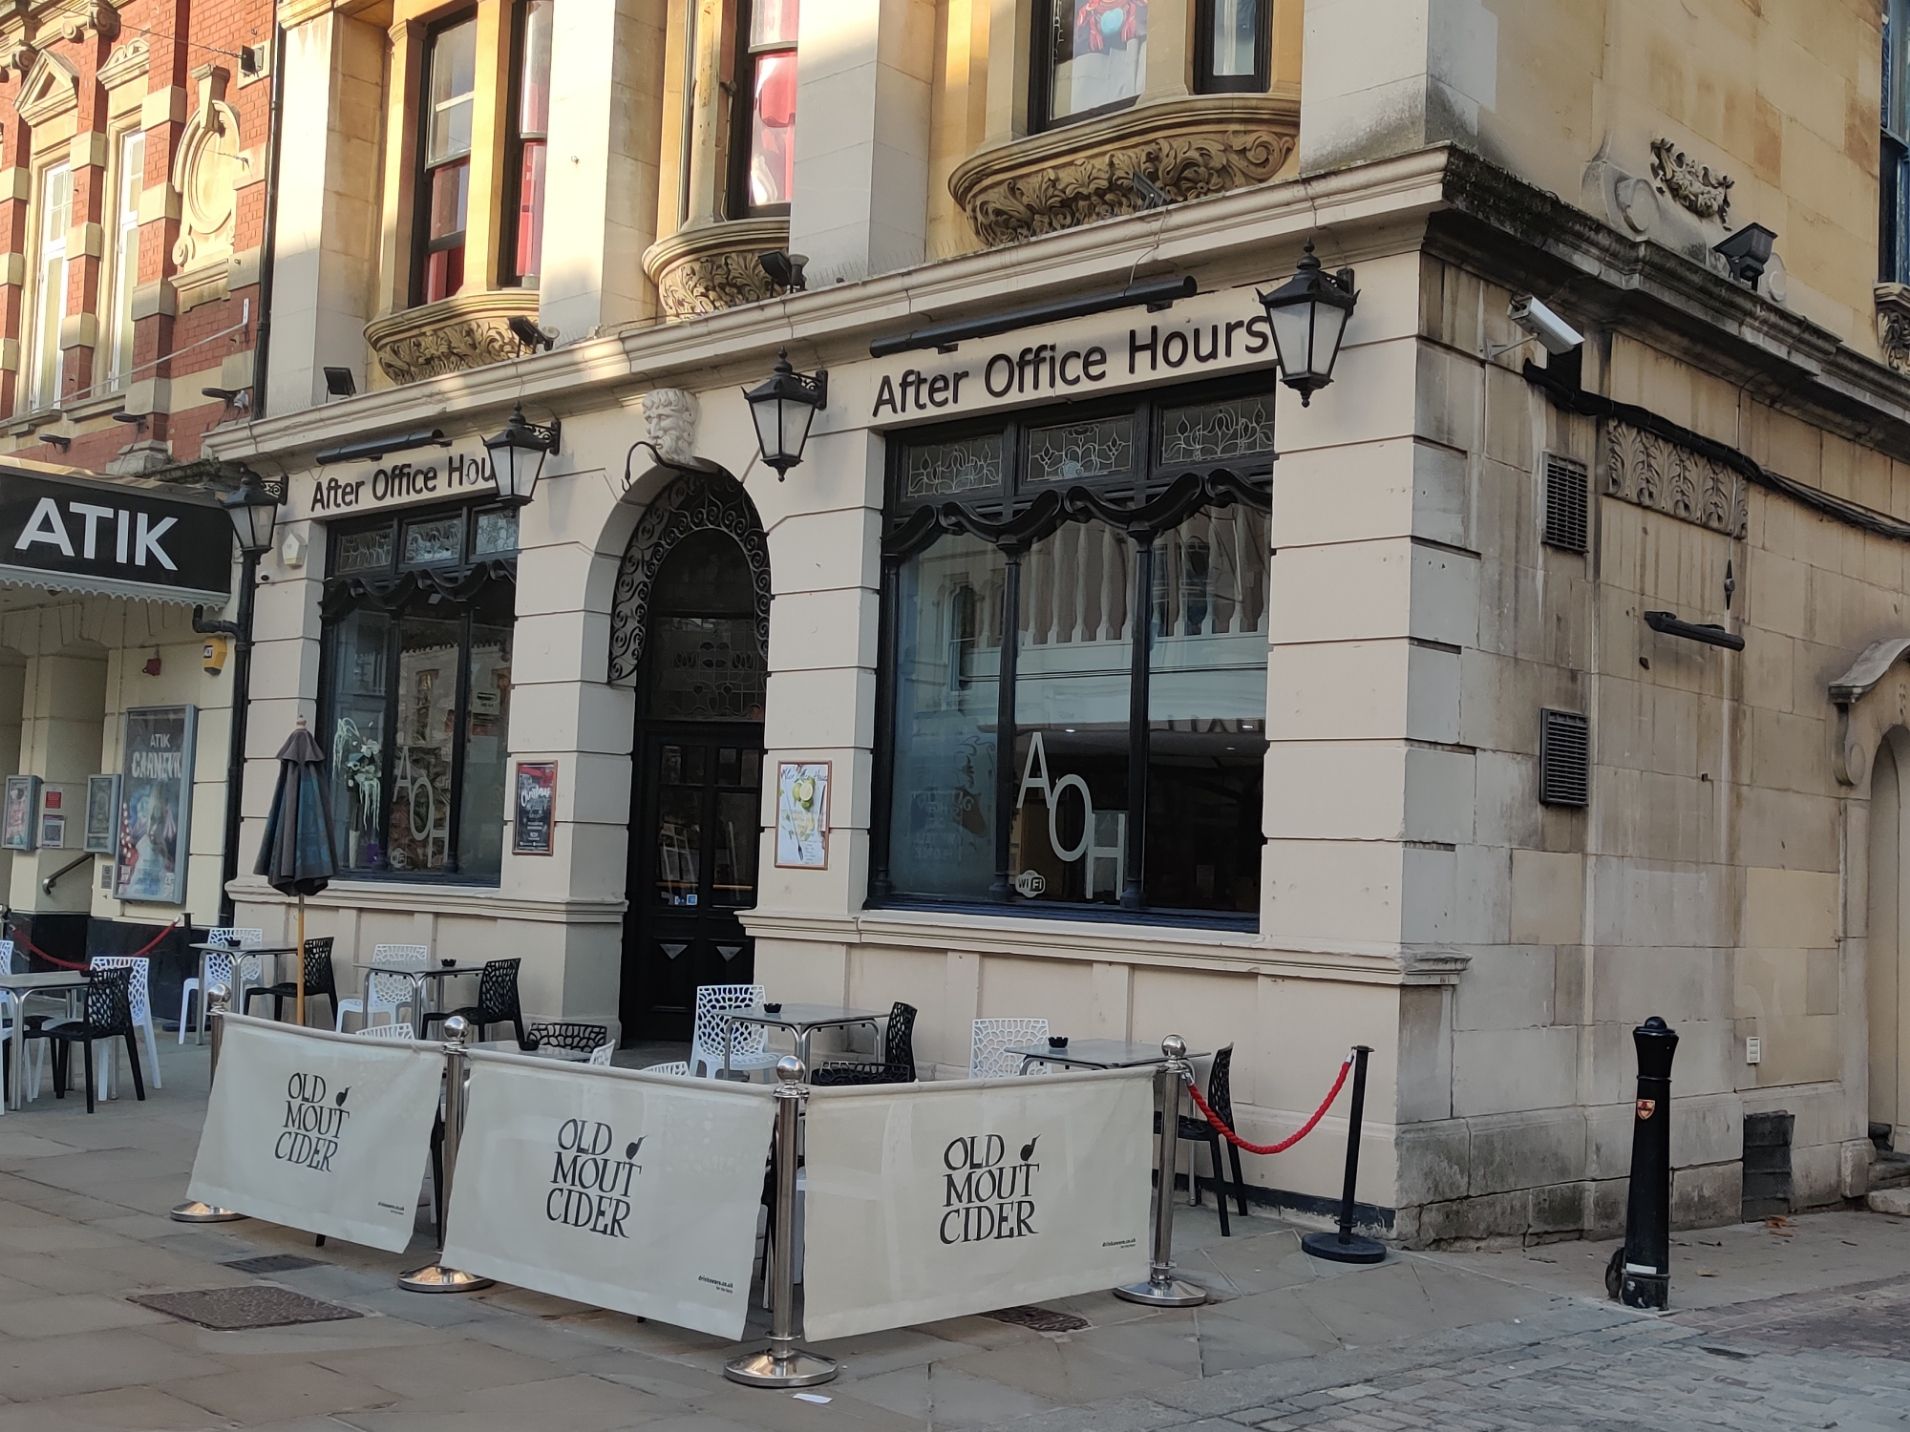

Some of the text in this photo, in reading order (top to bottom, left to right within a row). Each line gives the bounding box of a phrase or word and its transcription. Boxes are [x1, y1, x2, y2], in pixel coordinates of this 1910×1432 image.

[872, 314, 1270, 418] After Office Hours
[311, 453, 495, 513] After Office Hou
[14, 496, 179, 572] ATIK
[150, 733, 171, 748] ATIK
[287, 1071, 327, 1105] OLD
[284, 1101, 350, 1138] MOUT
[558, 1118, 613, 1155] OLD
[274, 1131, 340, 1173] CIDER
[550, 1151, 642, 1197] MOUT
[943, 1134, 1005, 1171] OLD
[942, 1163, 1040, 1207] MOUT
[546, 1187, 630, 1239] CIDER
[938, 1200, 1040, 1245] CIDER
